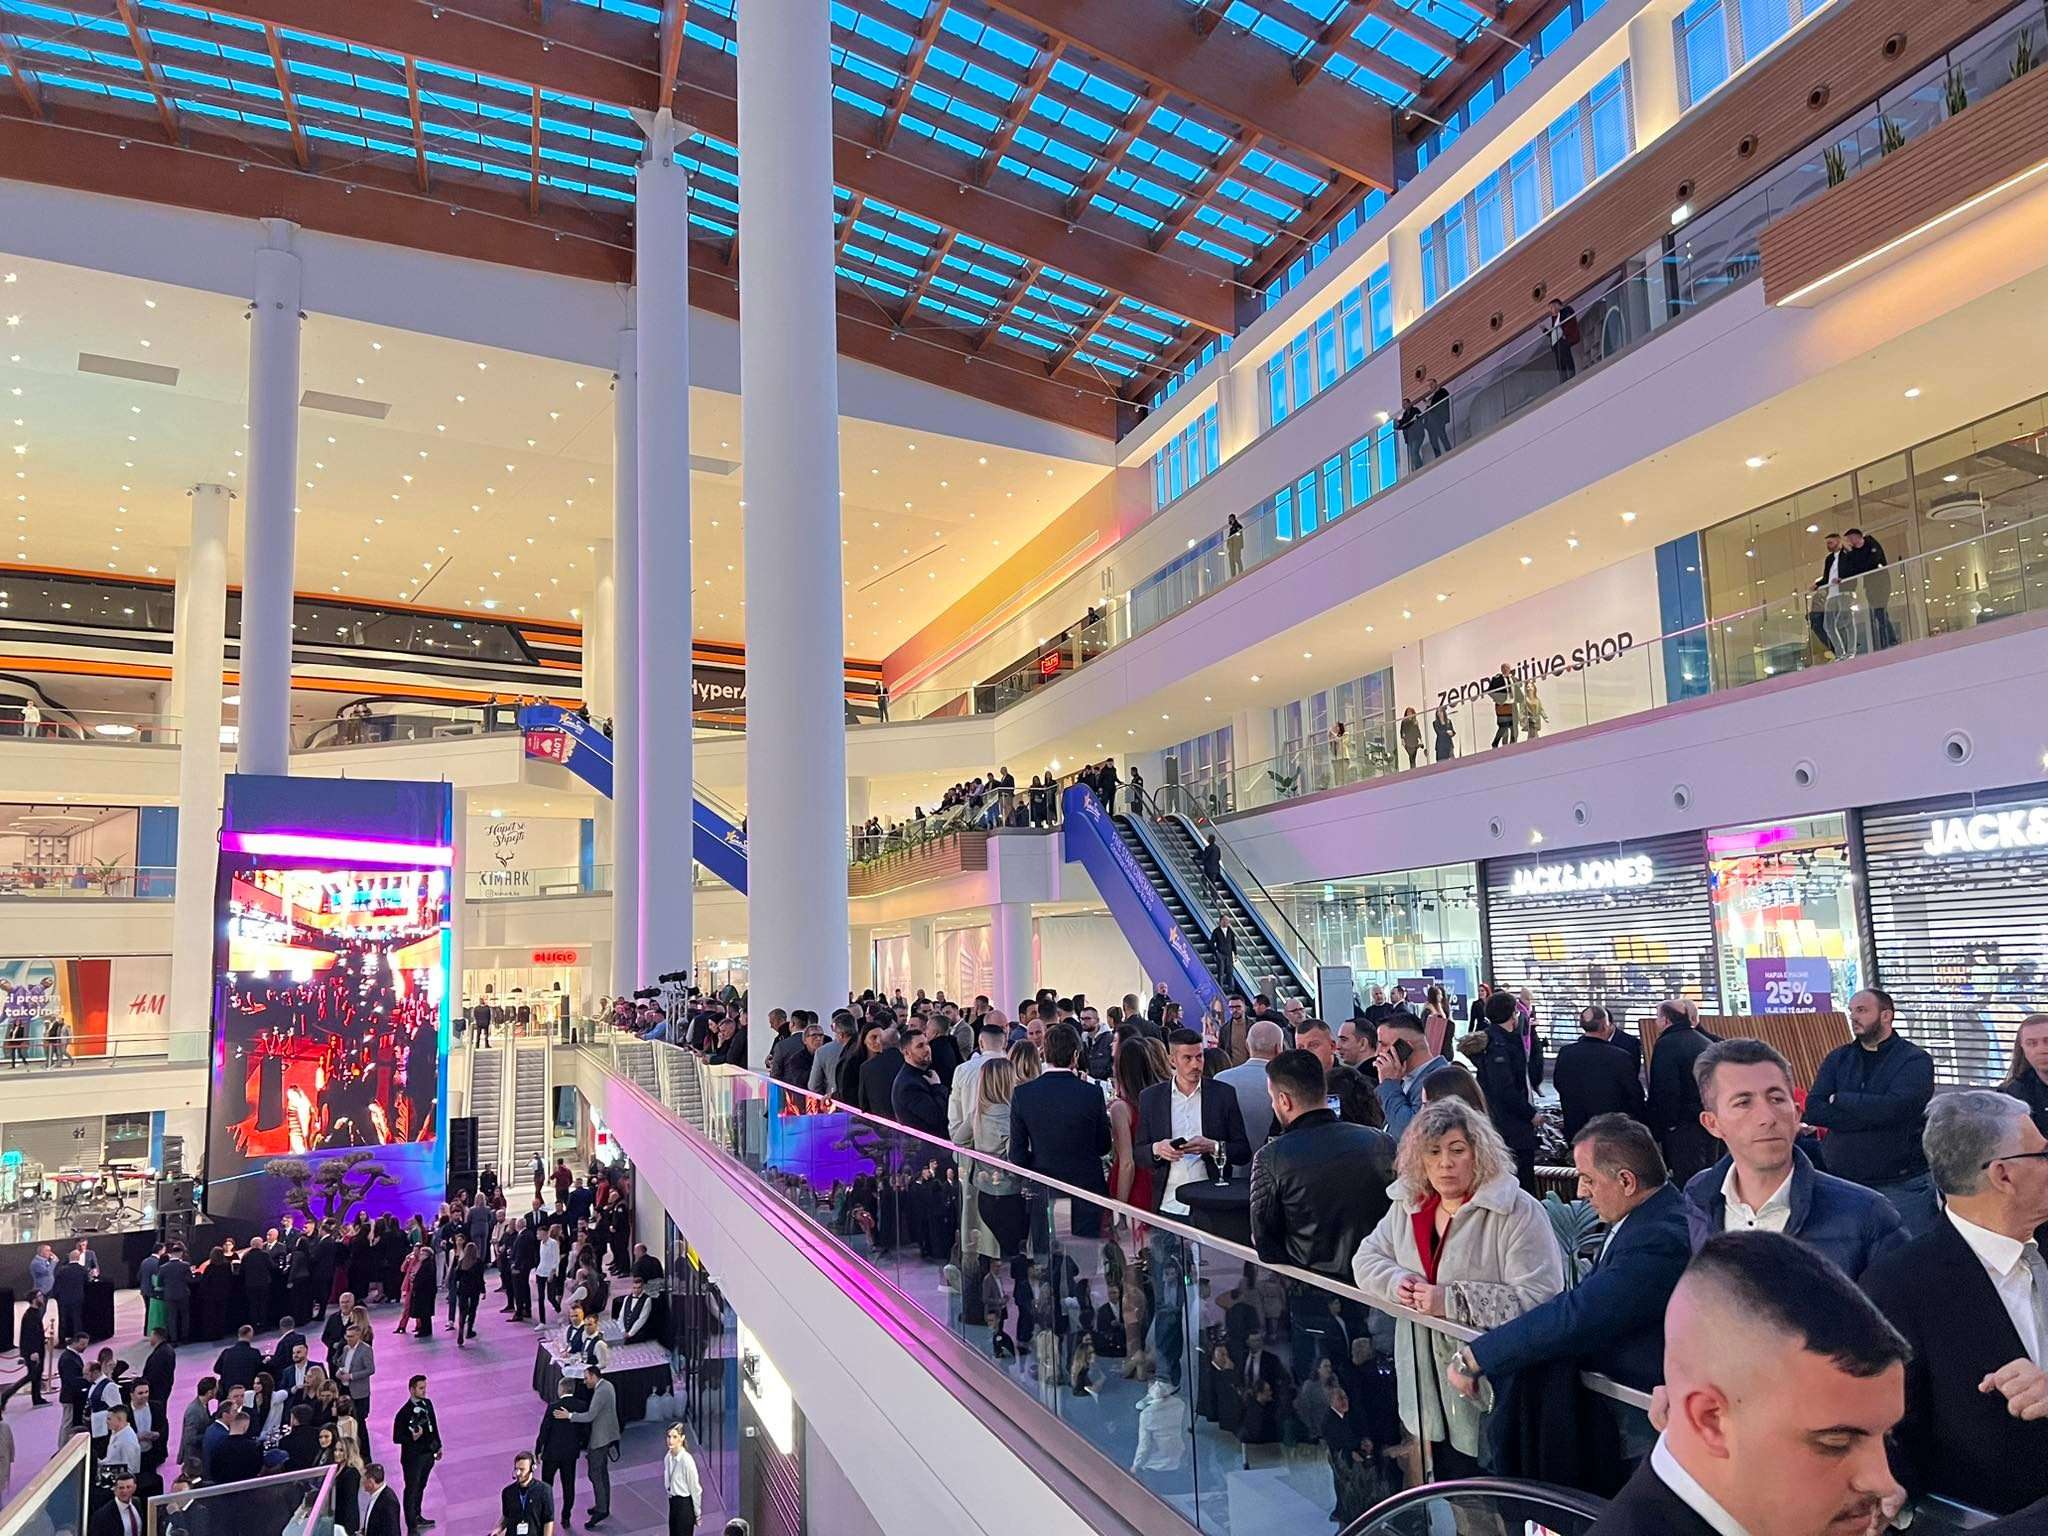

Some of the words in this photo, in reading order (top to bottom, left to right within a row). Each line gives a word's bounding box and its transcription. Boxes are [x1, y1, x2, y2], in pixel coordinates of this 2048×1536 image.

[1438, 632, 1633, 707] zeropitive.shop
[1511, 855, 1653, 896] JACK&JONES
[128, 993, 166, 1015] H&M
[1765, 981, 1813, 1005] 25%
